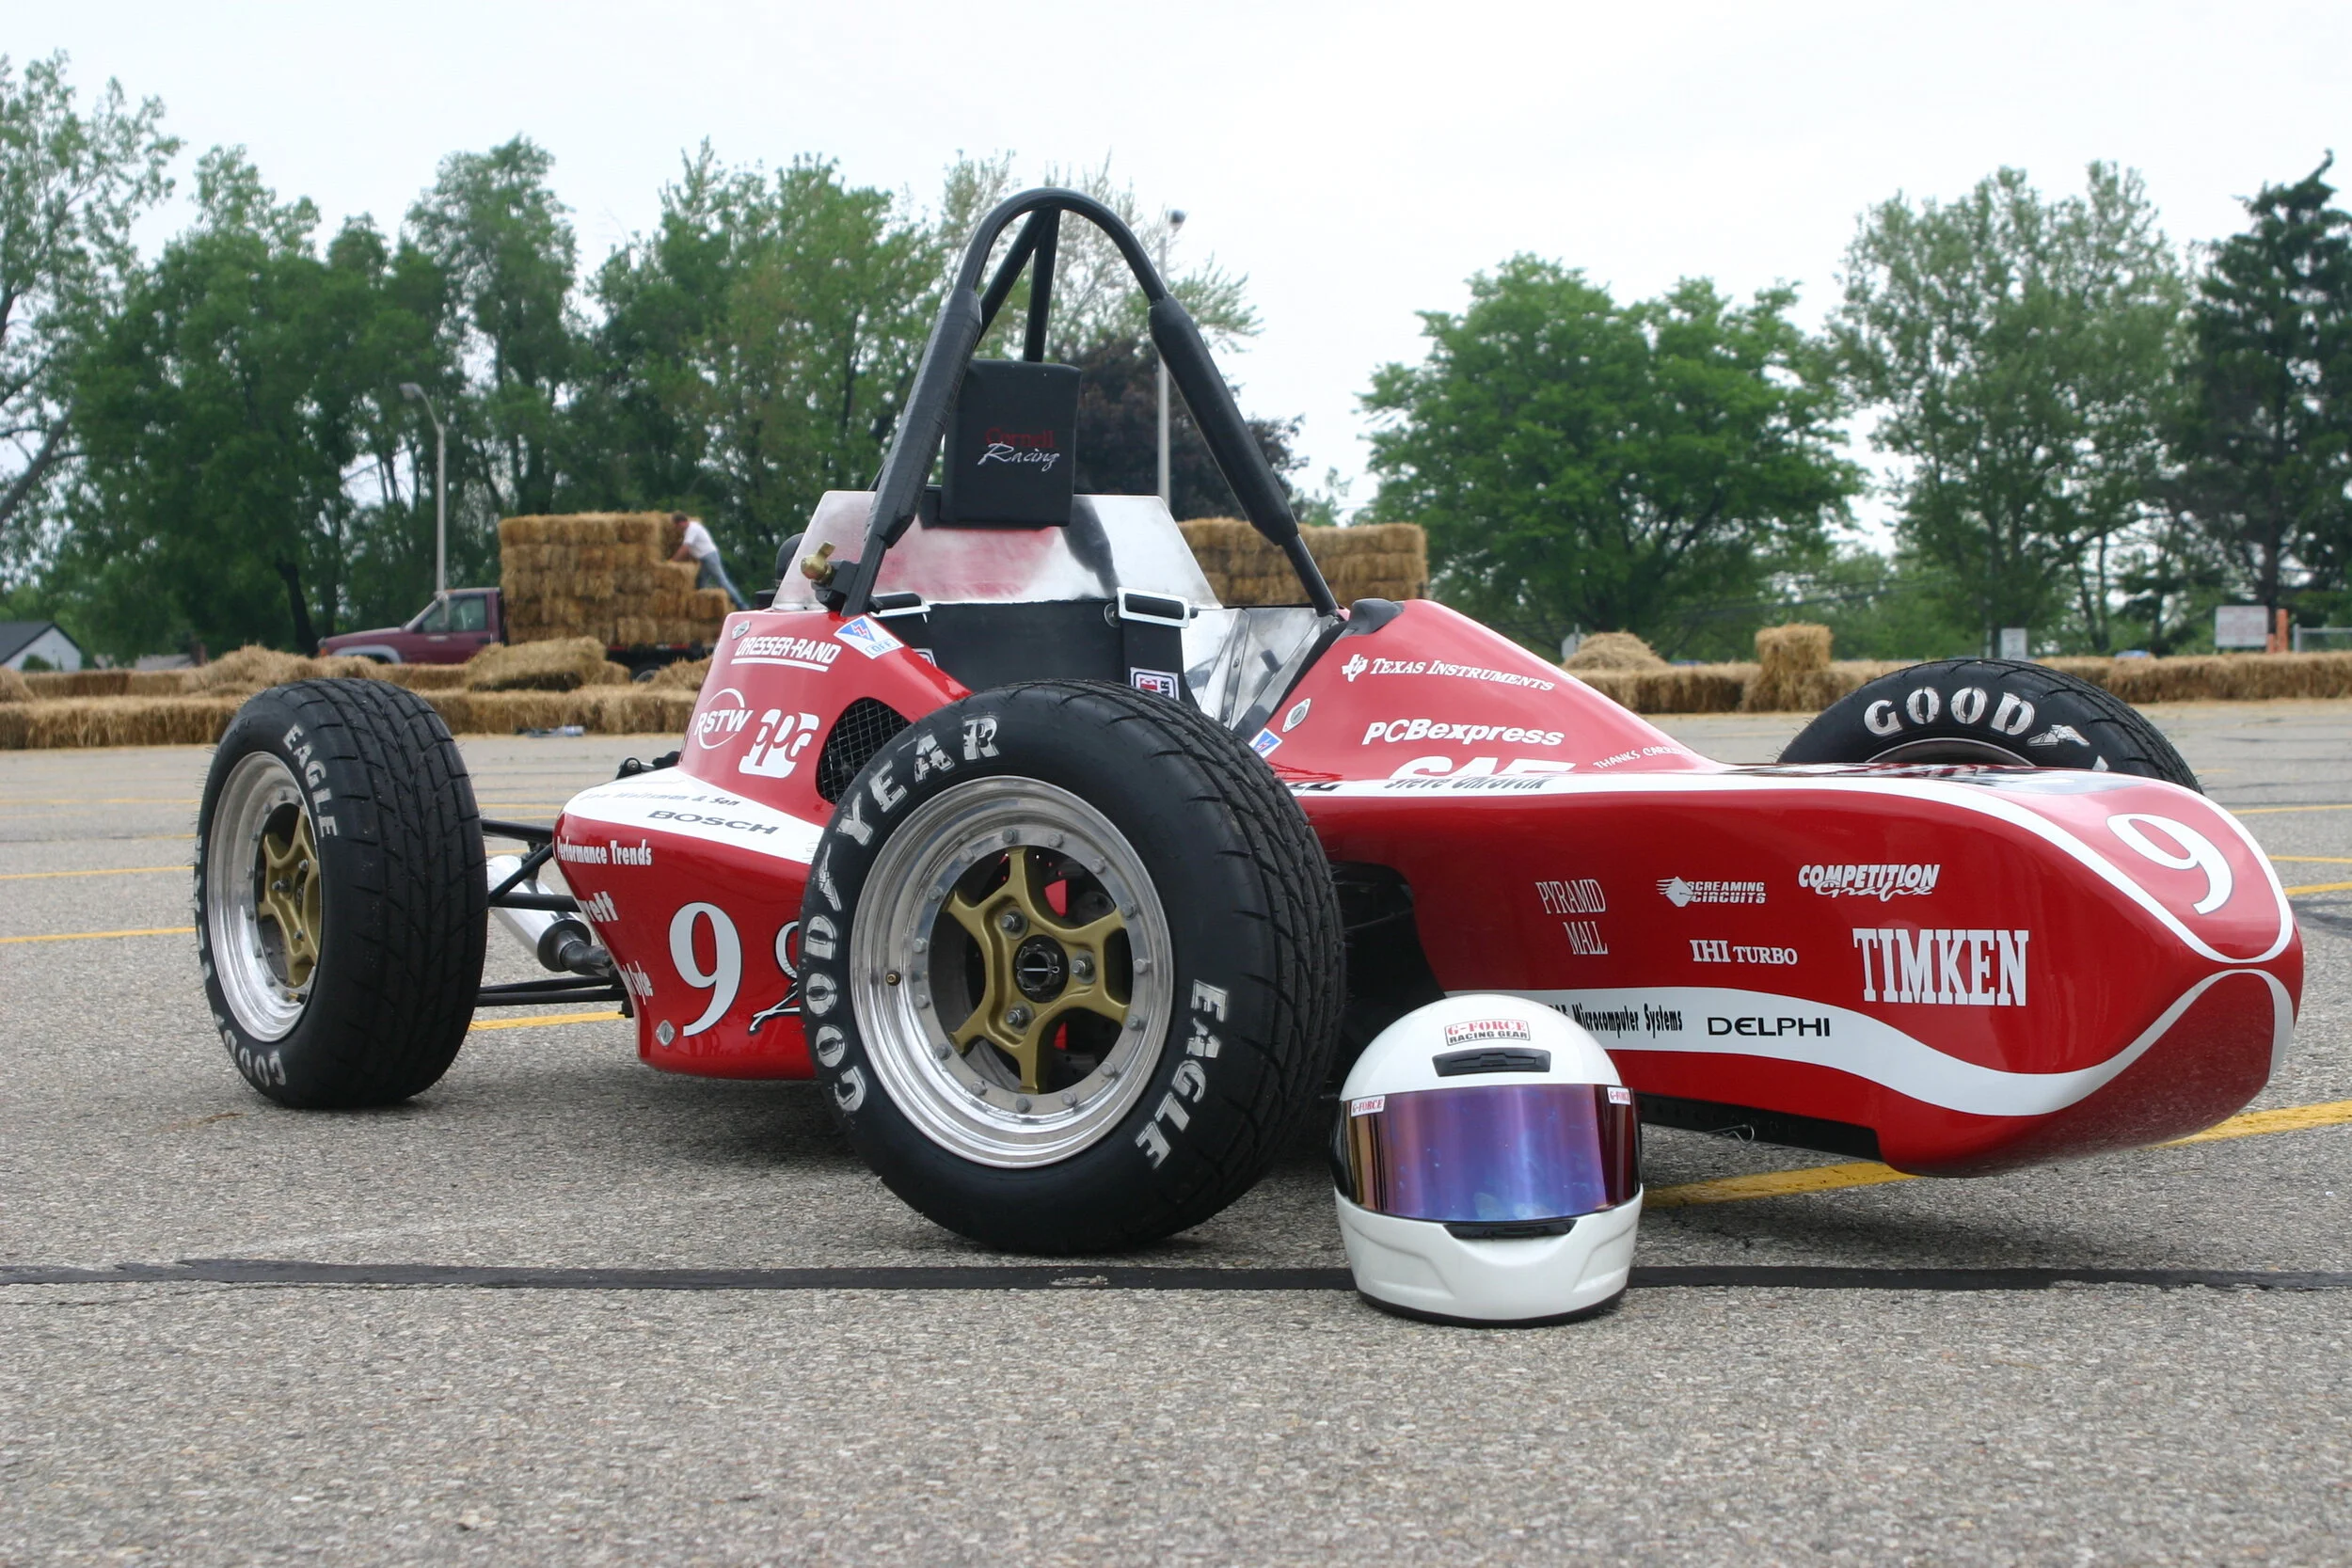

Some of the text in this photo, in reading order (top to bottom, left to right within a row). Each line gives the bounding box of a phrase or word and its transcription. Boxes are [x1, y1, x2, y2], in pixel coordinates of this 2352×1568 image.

[977, 442, 1060, 472] Racing
[735, 636, 842, 665] DRESSER-RAND
[871, 640, 893, 654] OFF
[1370, 657, 1555, 691] TEXAS INSTRUMENTS
[693, 709, 754, 736] RSTW
[1361, 718, 1565, 746] PCBexpress
[1593, 750, 1641, 768] THANKS
[283, 723, 339, 839] EAGLE
[646, 810, 780, 835] BOSCH
[557, 835, 653, 866] Performance Trends
[2106, 813, 2233, 916] 9
[1689, 880, 1765, 894] SCREAMING
[1798, 863, 1941, 889] COMPETITION
[1534, 878, 1607, 915] PYRAMID
[1691, 892, 1767, 905] CIRCUITS
[1563, 921, 1609, 956] MALL
[1690, 939, 1799, 966] IHI TURBO
[669, 900, 743, 1037] 9
[1851, 927, 2030, 1007] TIMKEN
[1448, 1020, 1527, 1036] G-FORCE
[1572, 1002, 1684, 1039] Microcomputer Systems
[1708, 1016, 1831, 1037] DELPHI
[1449, 1030, 1529, 1044] RACING GEAR
[1136, 978, 1229, 1170] EAGLE
